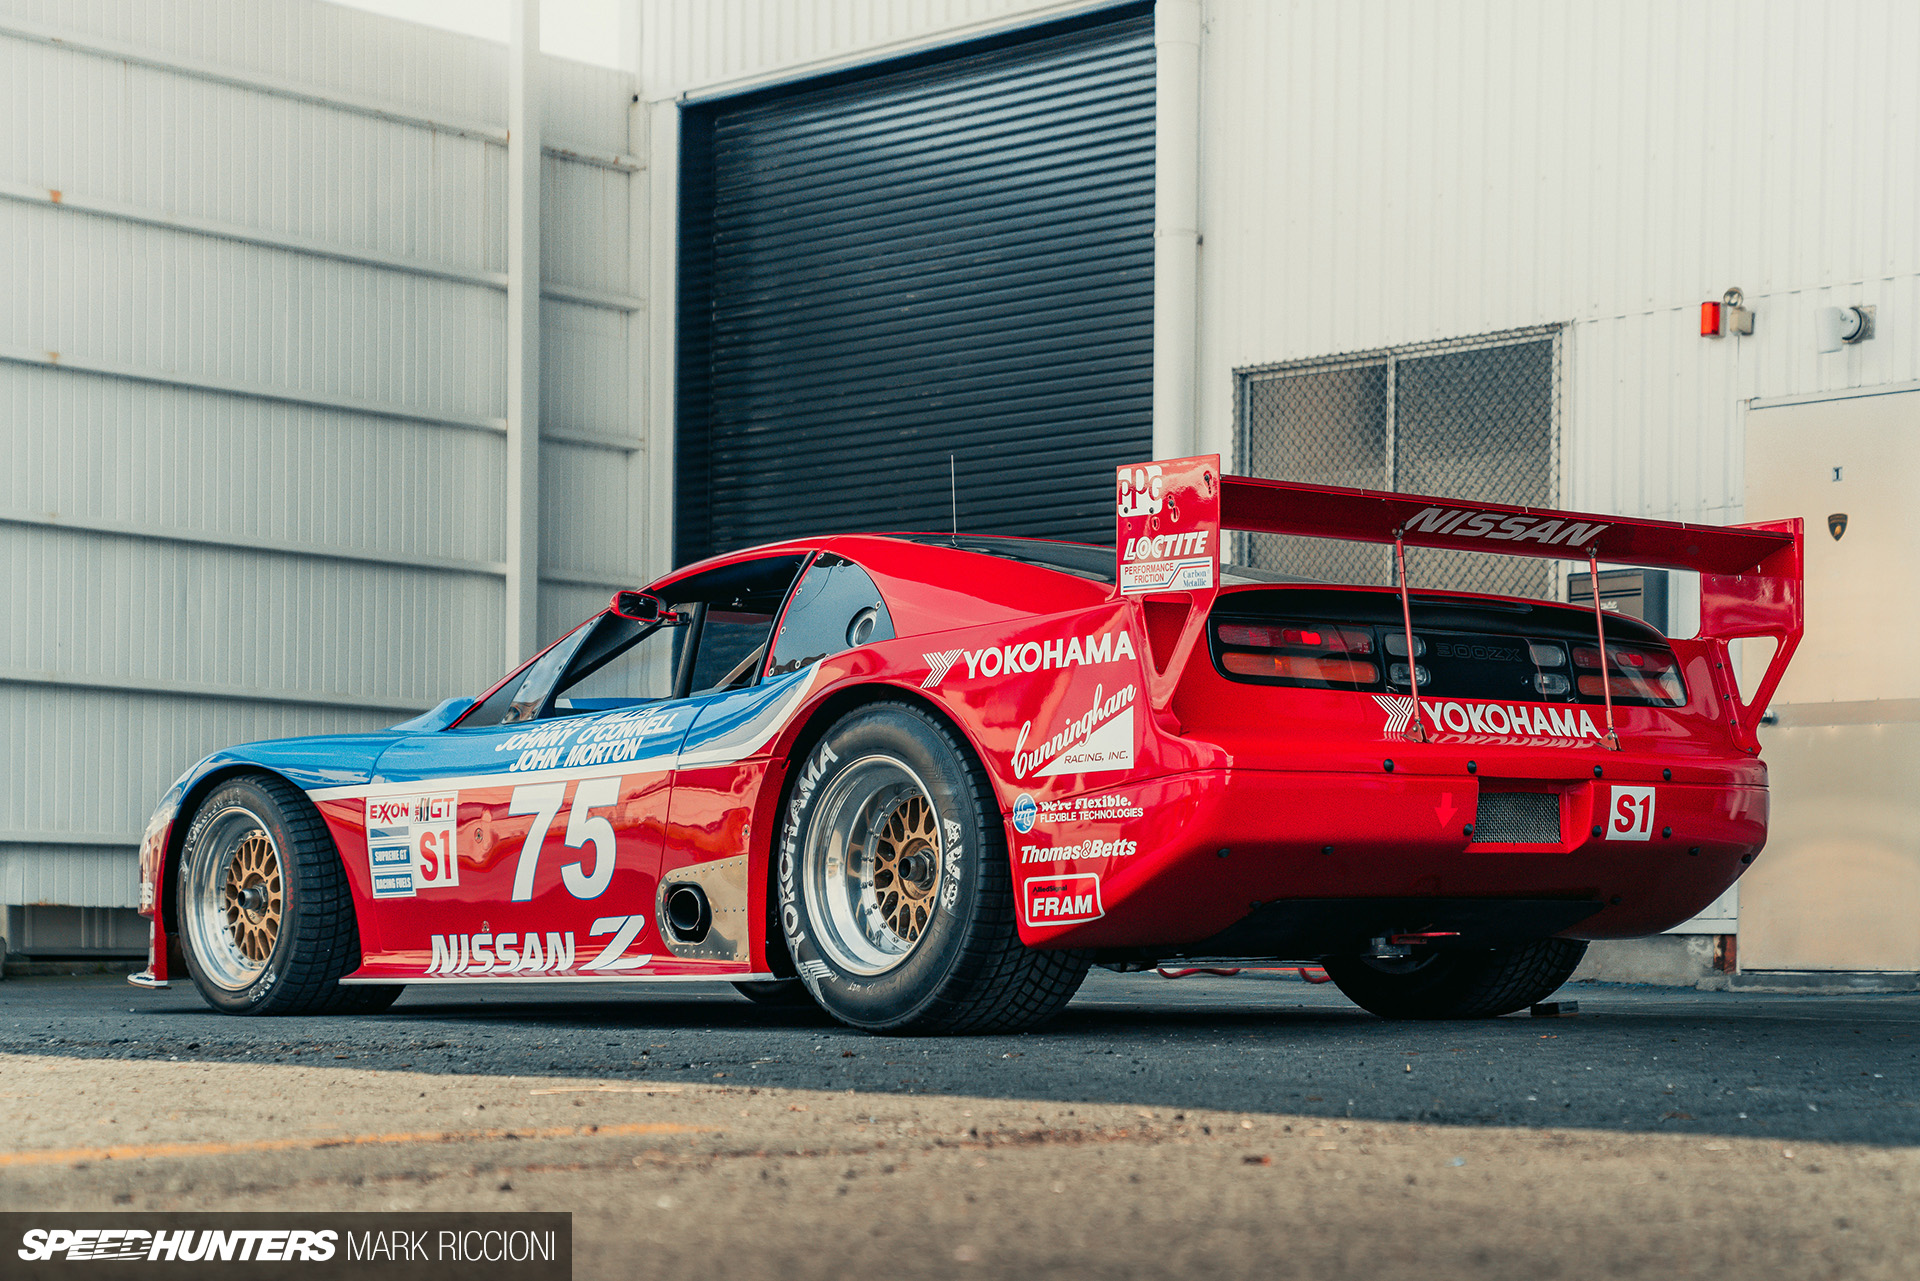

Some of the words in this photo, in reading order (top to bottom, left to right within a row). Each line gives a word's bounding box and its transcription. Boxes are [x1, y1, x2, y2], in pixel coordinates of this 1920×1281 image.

[1118, 466, 1162, 510] PPG
[1405, 507, 1610, 546] NISSAN
[1123, 530, 1209, 561] LOCTITE
[1124, 562, 1174, 575] PERFORMANCE
[1134, 573, 1165, 584] FRICTION
[1182, 569, 1207, 579] Carbon
[1183, 578, 1207, 588] Metallic
[963, 630, 1136, 679] YOKOHAMA
[1436, 643, 1522, 662] 300ZX
[495, 727, 581, 751] JOHNNY
[576, 713, 679, 744] O'CONNELL
[1011, 683, 1137, 779] Cunningham
[1421, 701, 1603, 739] YOKOHAMA
[509, 746, 565, 772] JOHN
[563, 737, 644, 767] MORTON
[1064, 752, 1104, 764] RACING,
[1108, 750, 1128, 760] INC.
[370, 801, 409, 824] EXXON
[430, 797, 454, 818] GT
[1039, 800, 1072, 812] We're
[1075, 795, 1132, 809] Flexible.
[1040, 812, 1077, 823] FLEXIBLE
[1079, 808, 1144, 820] TECHNOLOGIES
[1613, 793, 1652, 834] S1
[508, 776, 622, 902] 75
[1021, 838, 1137, 864] Thomas&Betts
[375, 850, 400, 861] SUPREME
[400, 849, 407, 860] GT
[420, 830, 452, 881] S1
[779, 741, 838, 968] YOKOHAMA
[376, 878, 395, 889] RACING
[396, 877, 411, 888] FUELS
[1032, 894, 1093, 917] FRAM
[424, 931, 575, 974] NISSAN
[578, 914, 652, 971] Z
